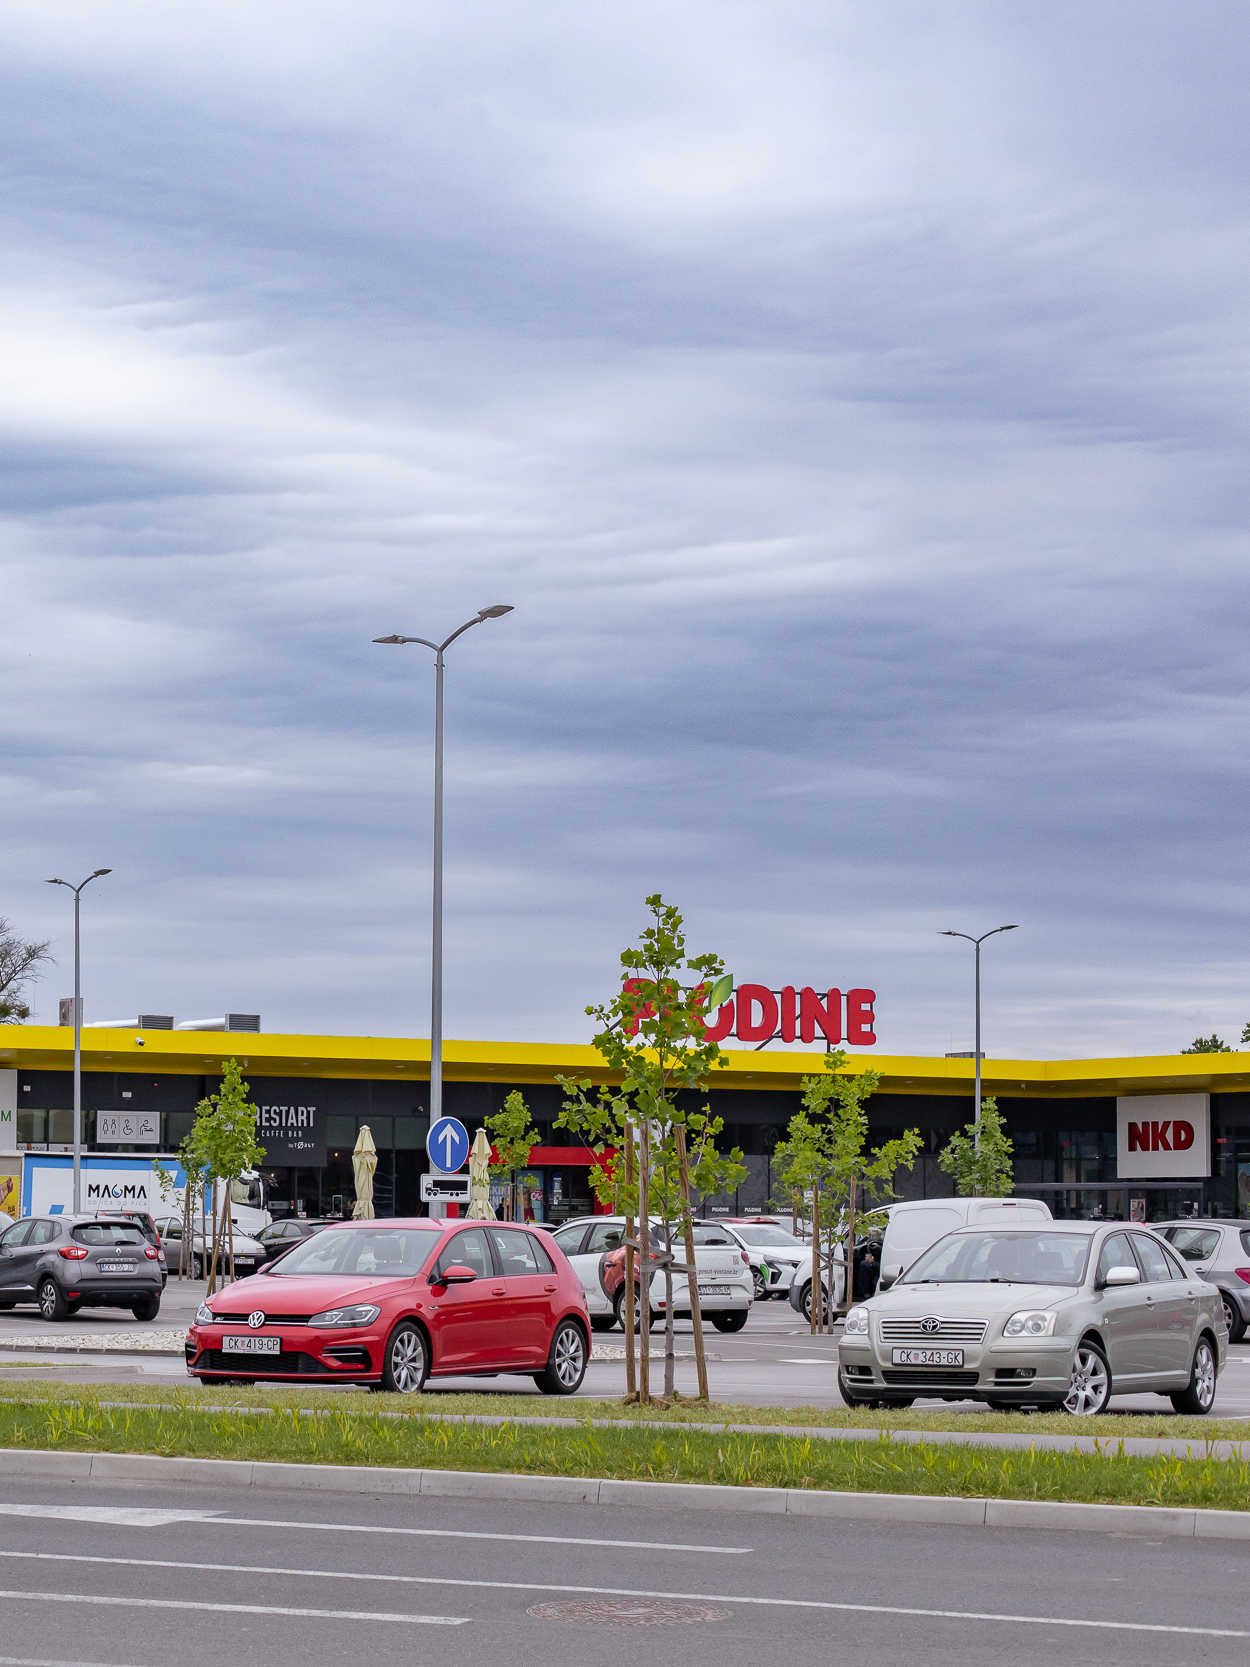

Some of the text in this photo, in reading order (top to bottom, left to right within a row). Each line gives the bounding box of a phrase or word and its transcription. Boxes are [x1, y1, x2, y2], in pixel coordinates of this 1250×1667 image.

[623, 977, 877, 1045] PODINE
[1127, 1120, 1195, 1152] NKD
[228, 1337, 279, 1350] CK 419-CP
[899, 1350, 961, 1364] CK 343-GK
